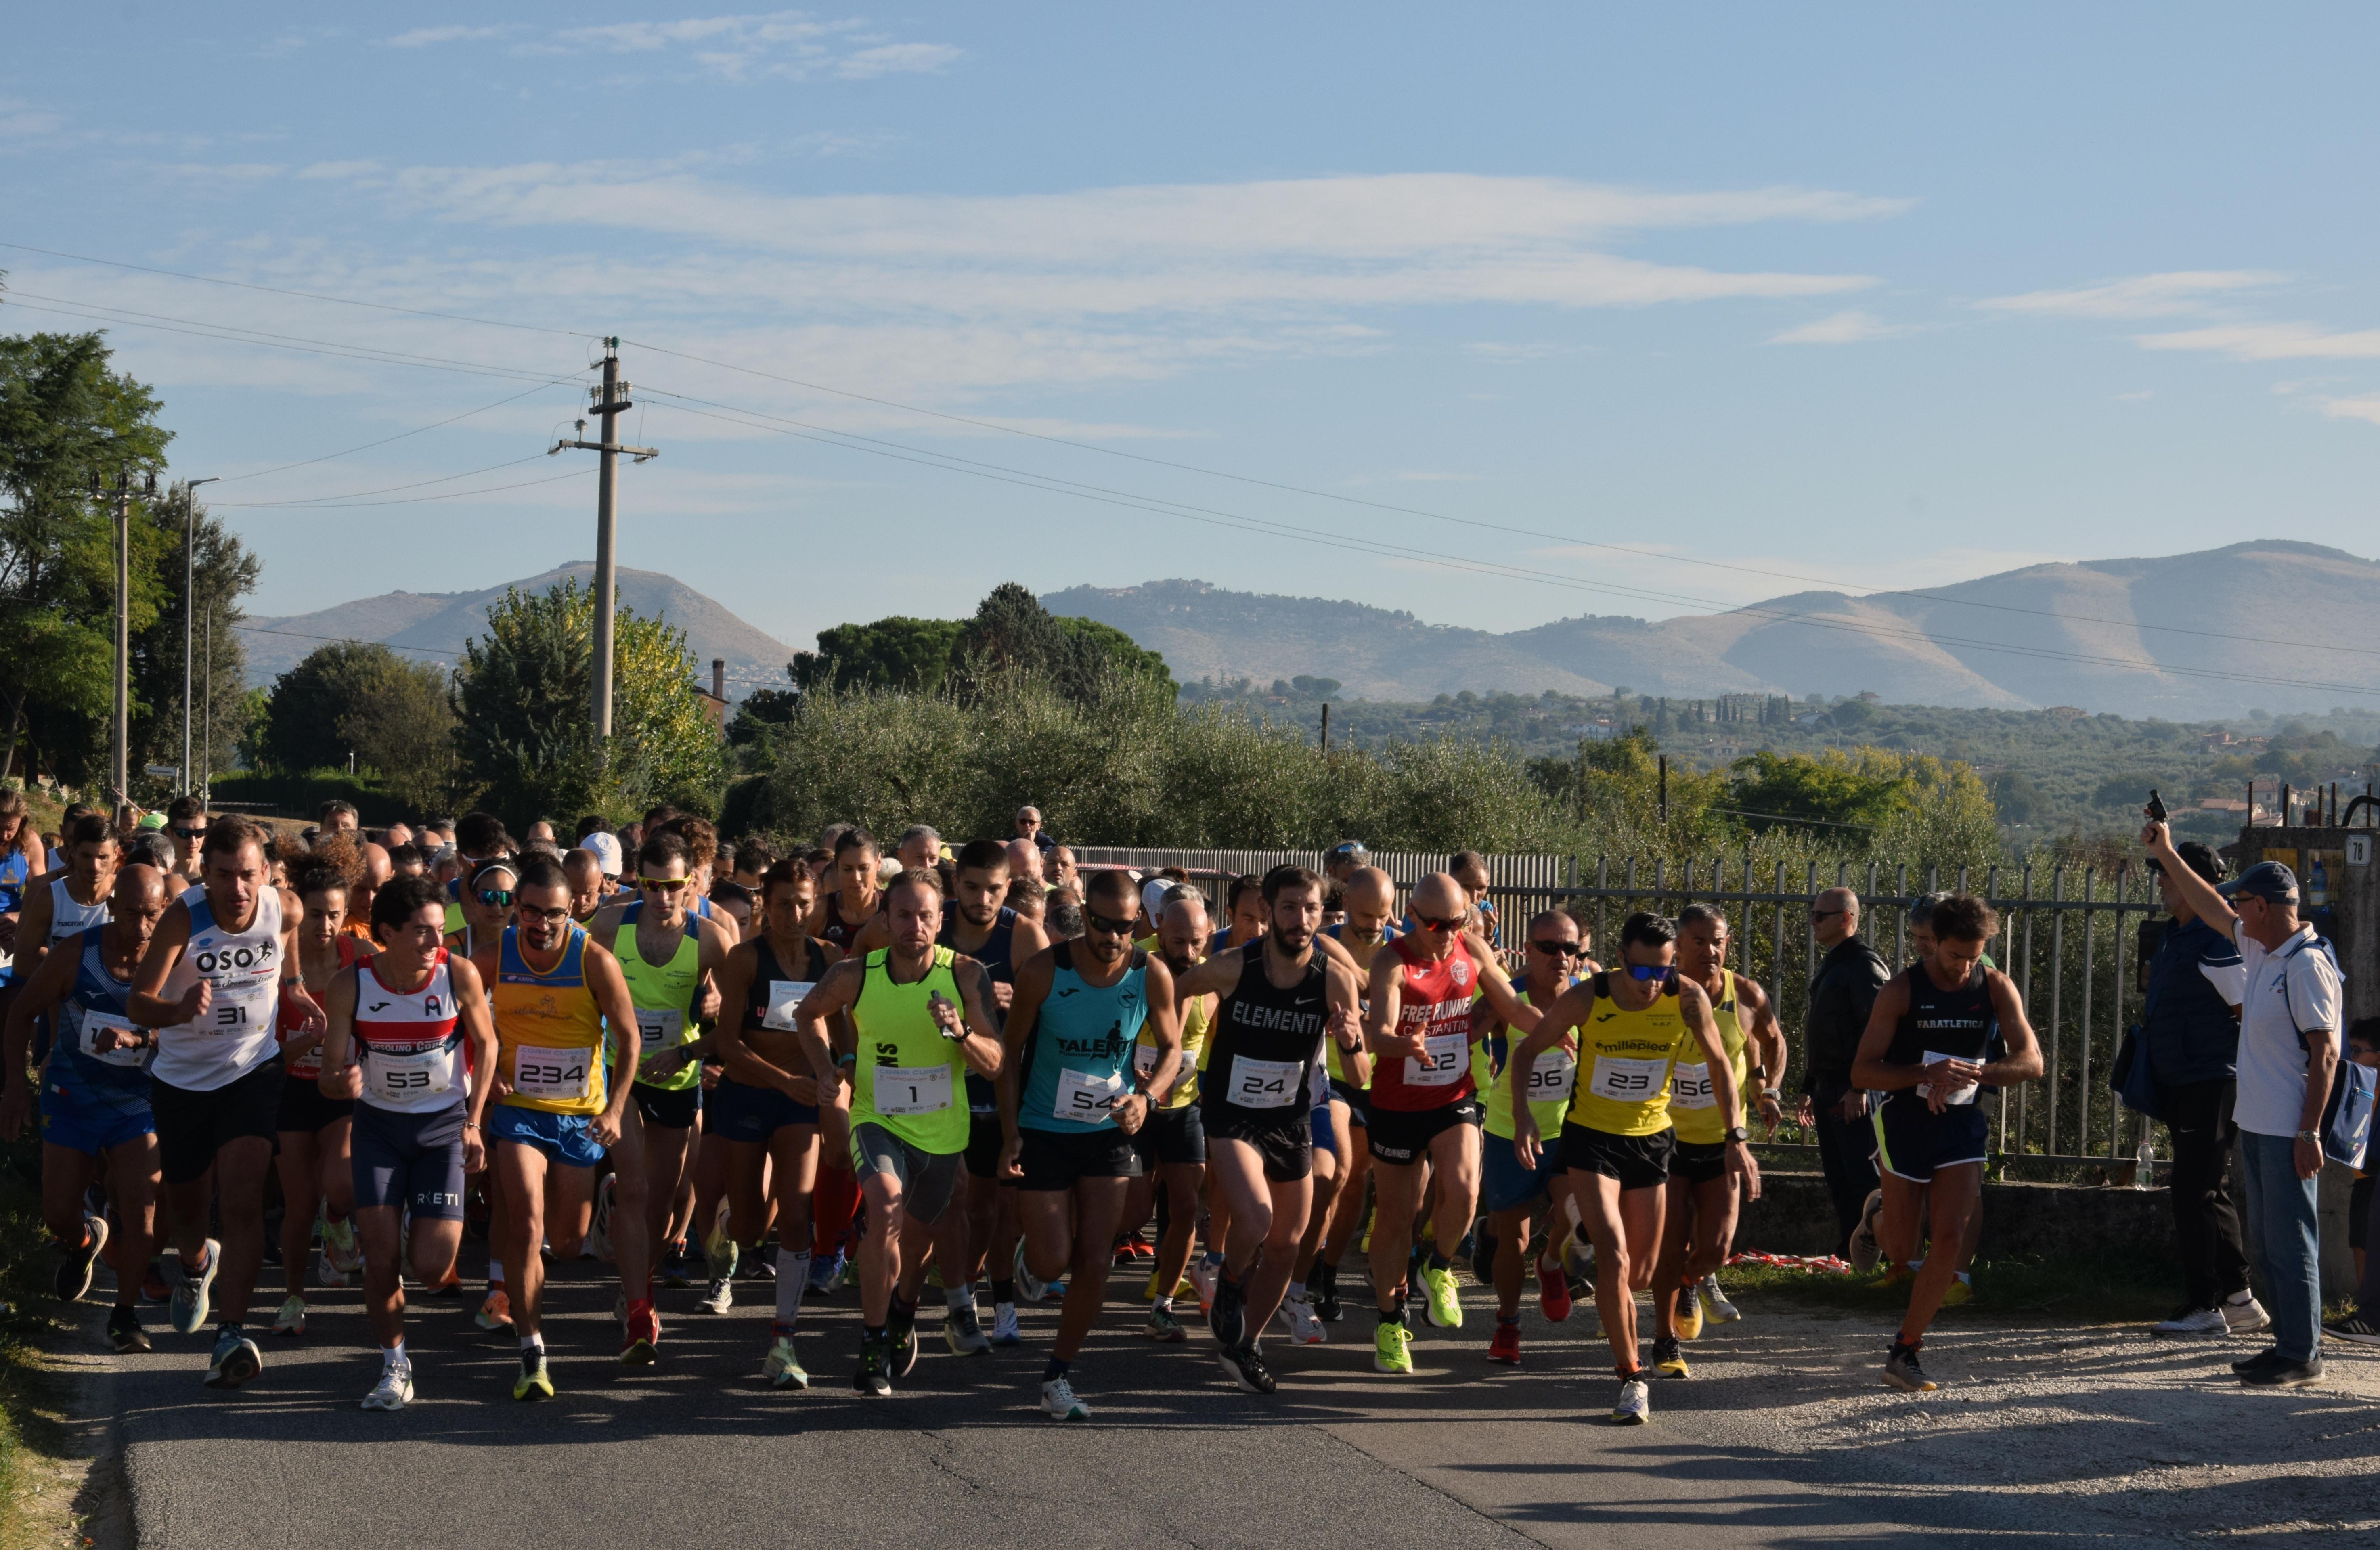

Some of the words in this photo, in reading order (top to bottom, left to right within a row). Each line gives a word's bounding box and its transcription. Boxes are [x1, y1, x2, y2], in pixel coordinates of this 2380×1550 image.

[2353, 842, 2363, 861] 78
[197, 948, 254, 972] OSO
[218, 1006, 247, 1025] 31
[1232, 1000, 1321, 1034] ELEMENTI
[1400, 1004, 1433, 1022] FREE
[1403, 1018, 1469, 1037] CSTANTIN
[1917, 1019, 1984, 1028] FARATLETICA
[1420, 1052, 1456, 1072] 22
[386, 1071, 430, 1089] 53
[520, 1064, 585, 1084] 234
[1608, 1072, 1649, 1089] 23
[909, 1086, 917, 1103] 1
[1243, 1076, 1285, 1094] 24
[1072, 1091, 1115, 1110] 54
[1384, 1148, 1410, 1159] RUNNERS
